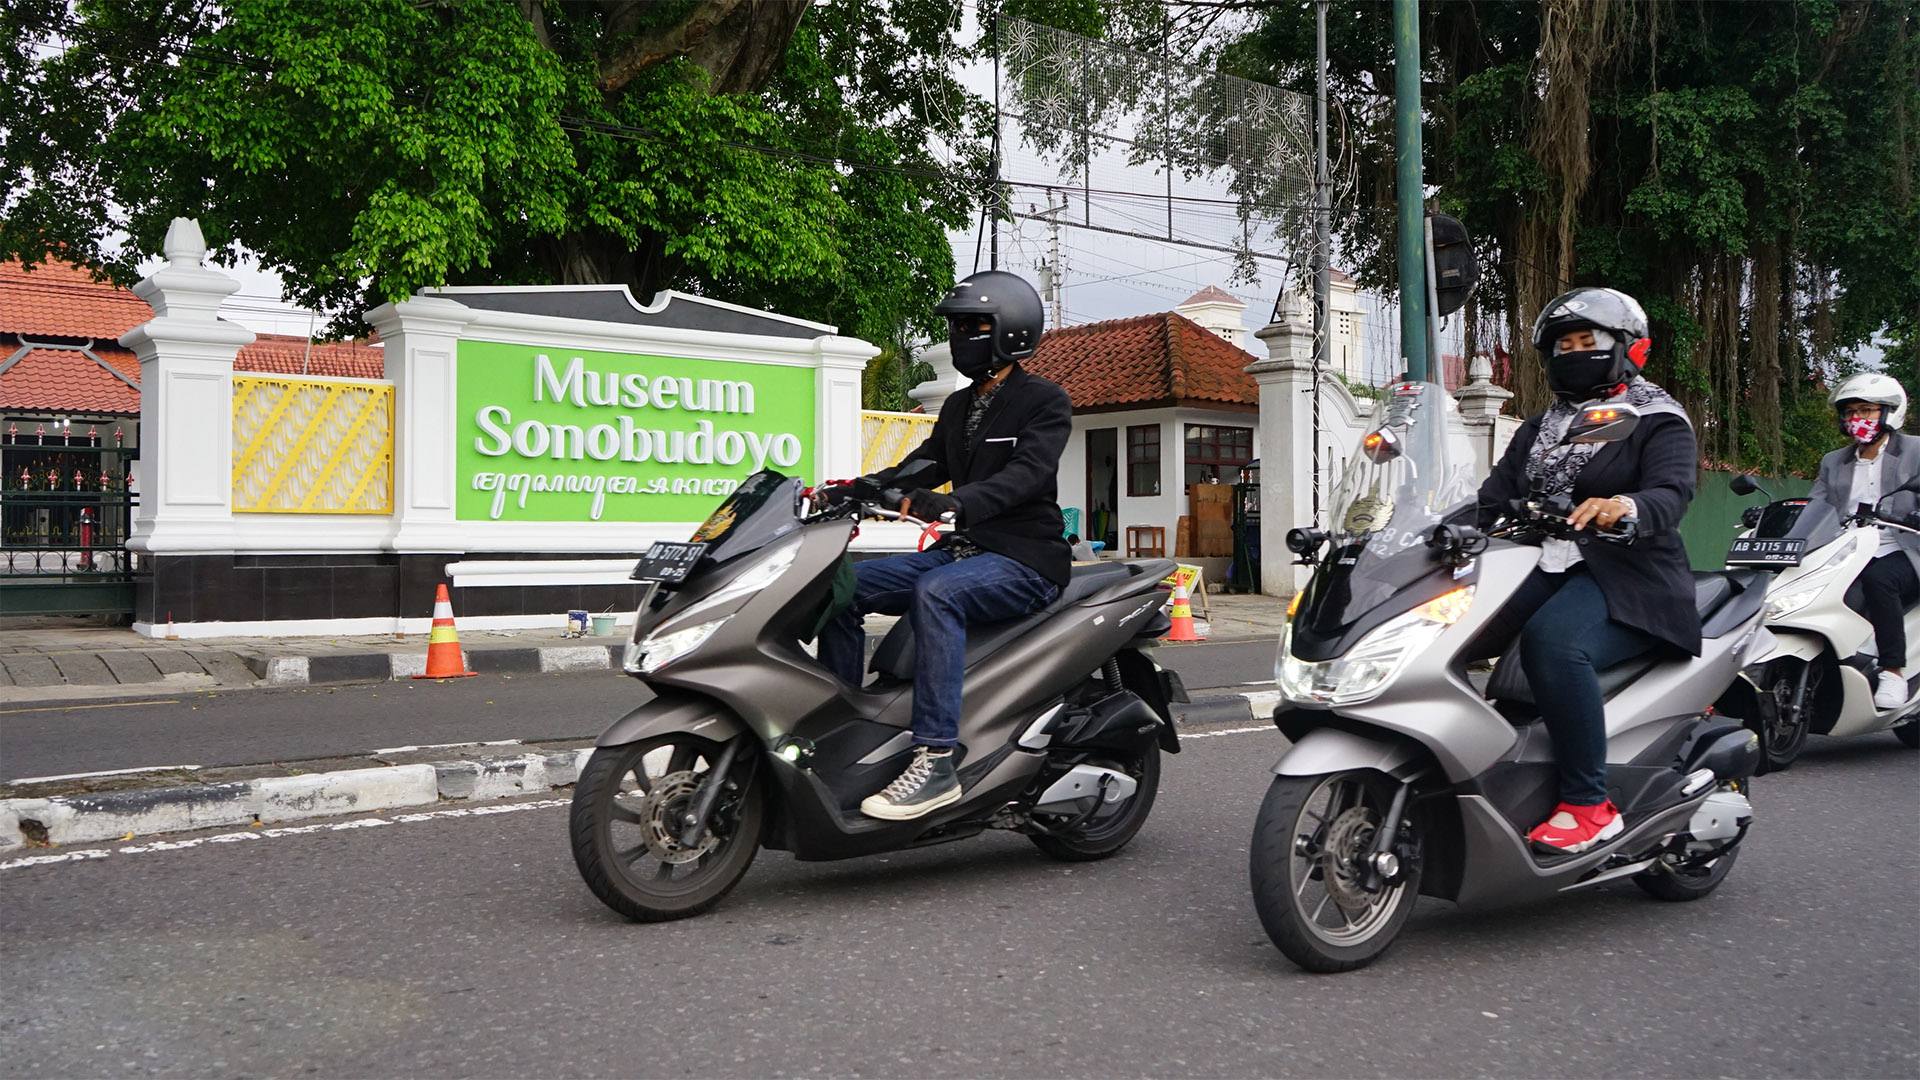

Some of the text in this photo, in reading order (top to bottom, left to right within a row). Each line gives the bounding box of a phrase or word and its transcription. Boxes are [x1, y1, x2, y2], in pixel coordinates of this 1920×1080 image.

[533, 354, 754, 413] Museum
[474, 405, 801, 476] Sonobudoyo
[1735, 542, 1750, 551] AB
[1753, 542, 1781, 551] 3115
